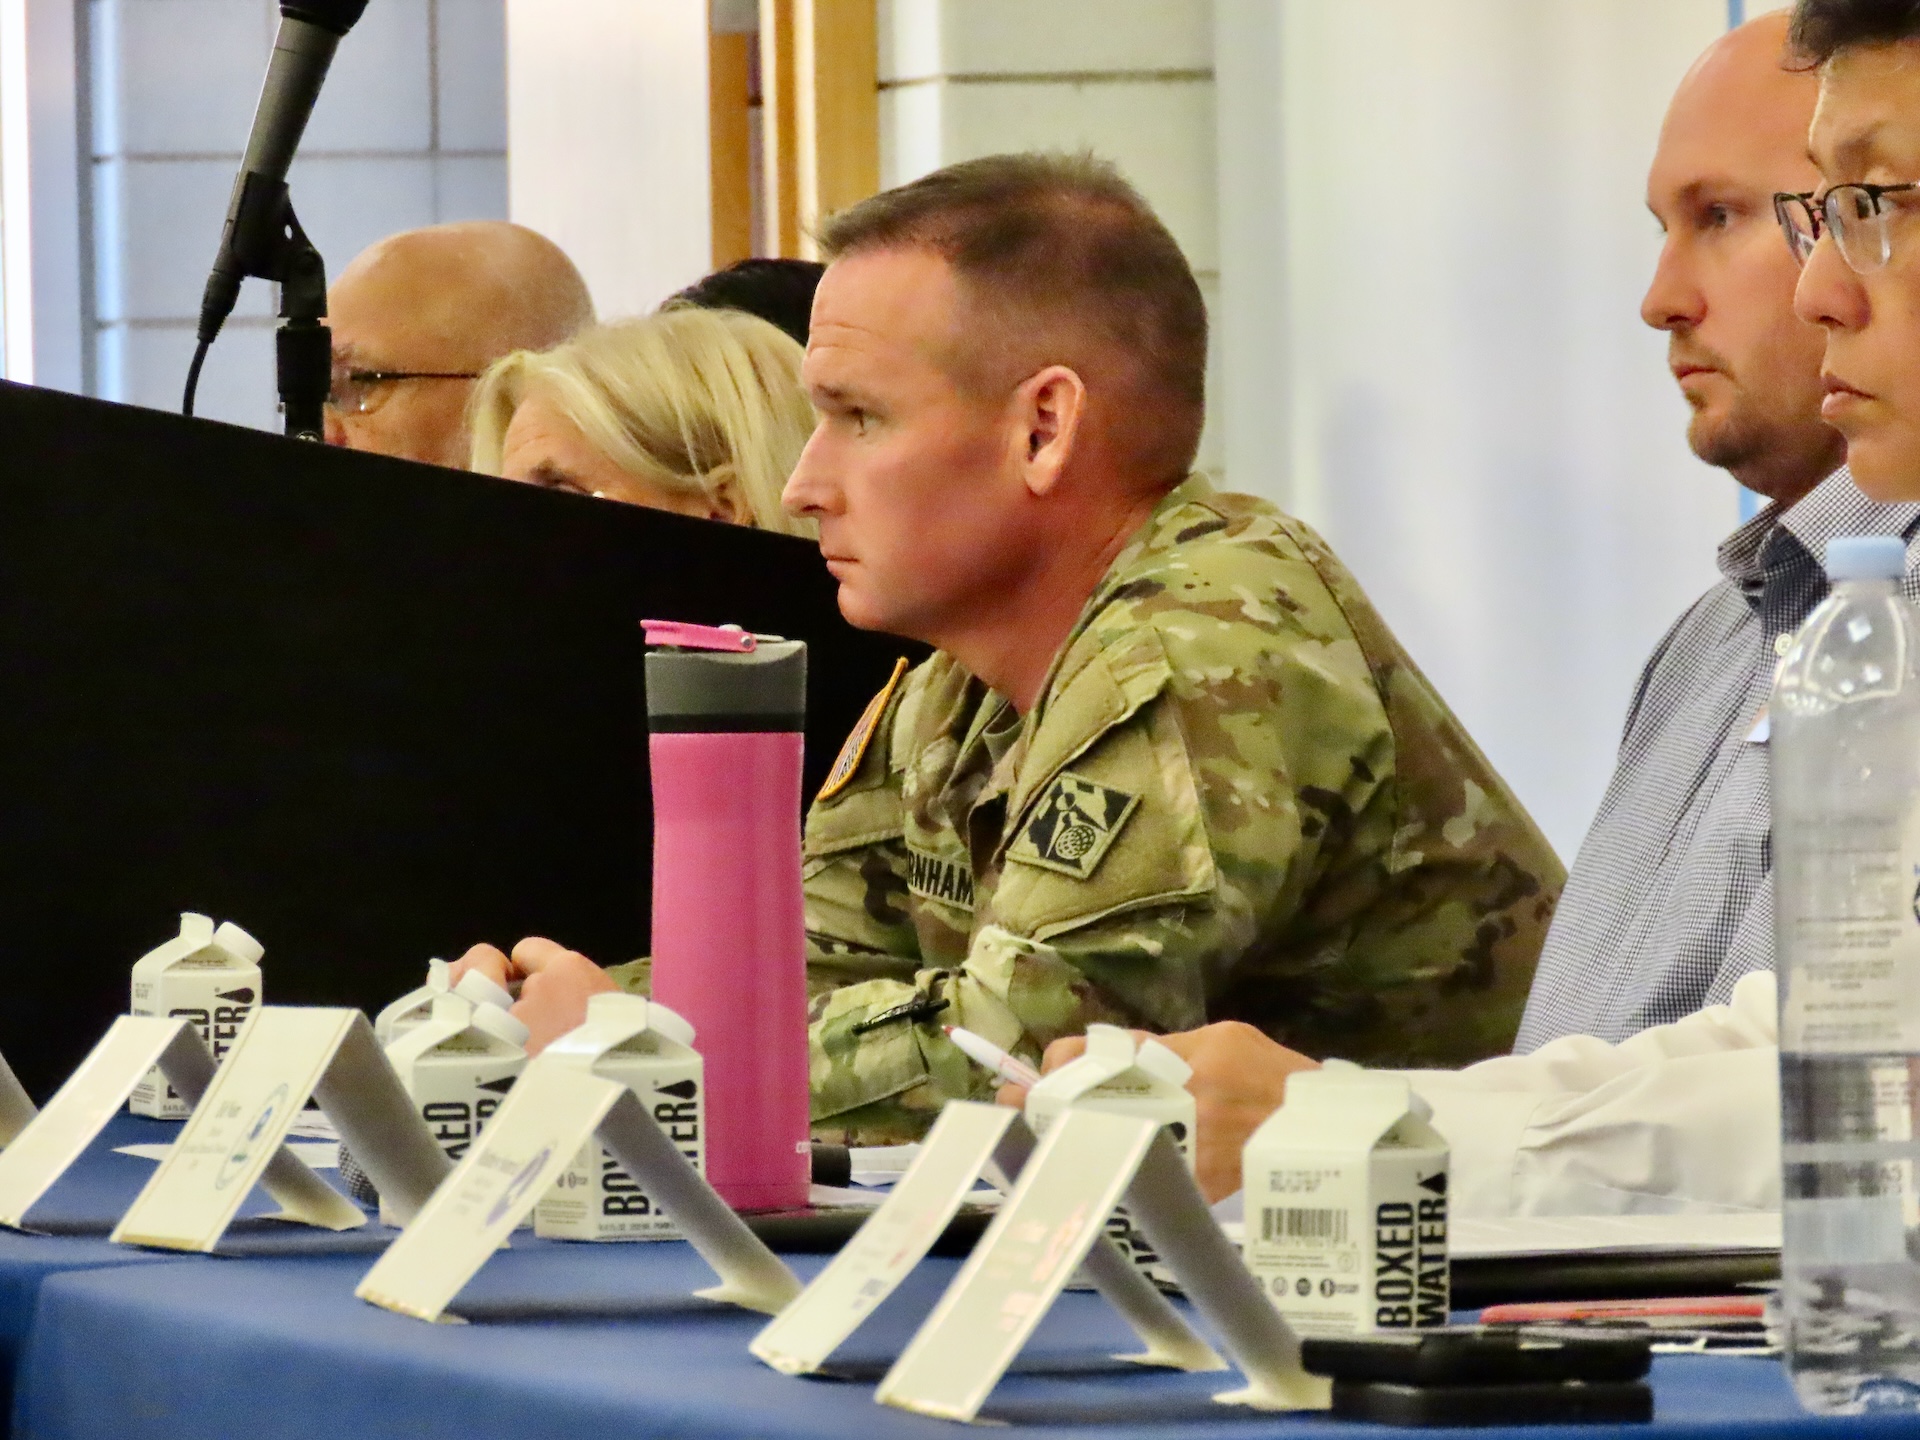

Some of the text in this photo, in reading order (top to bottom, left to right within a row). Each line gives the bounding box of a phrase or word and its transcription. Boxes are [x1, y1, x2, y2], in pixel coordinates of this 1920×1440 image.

[214, 1006, 252, 1063] TER
[1375, 1202, 1415, 1328] BOXED
[1416, 1198, 1448, 1328] WATER
